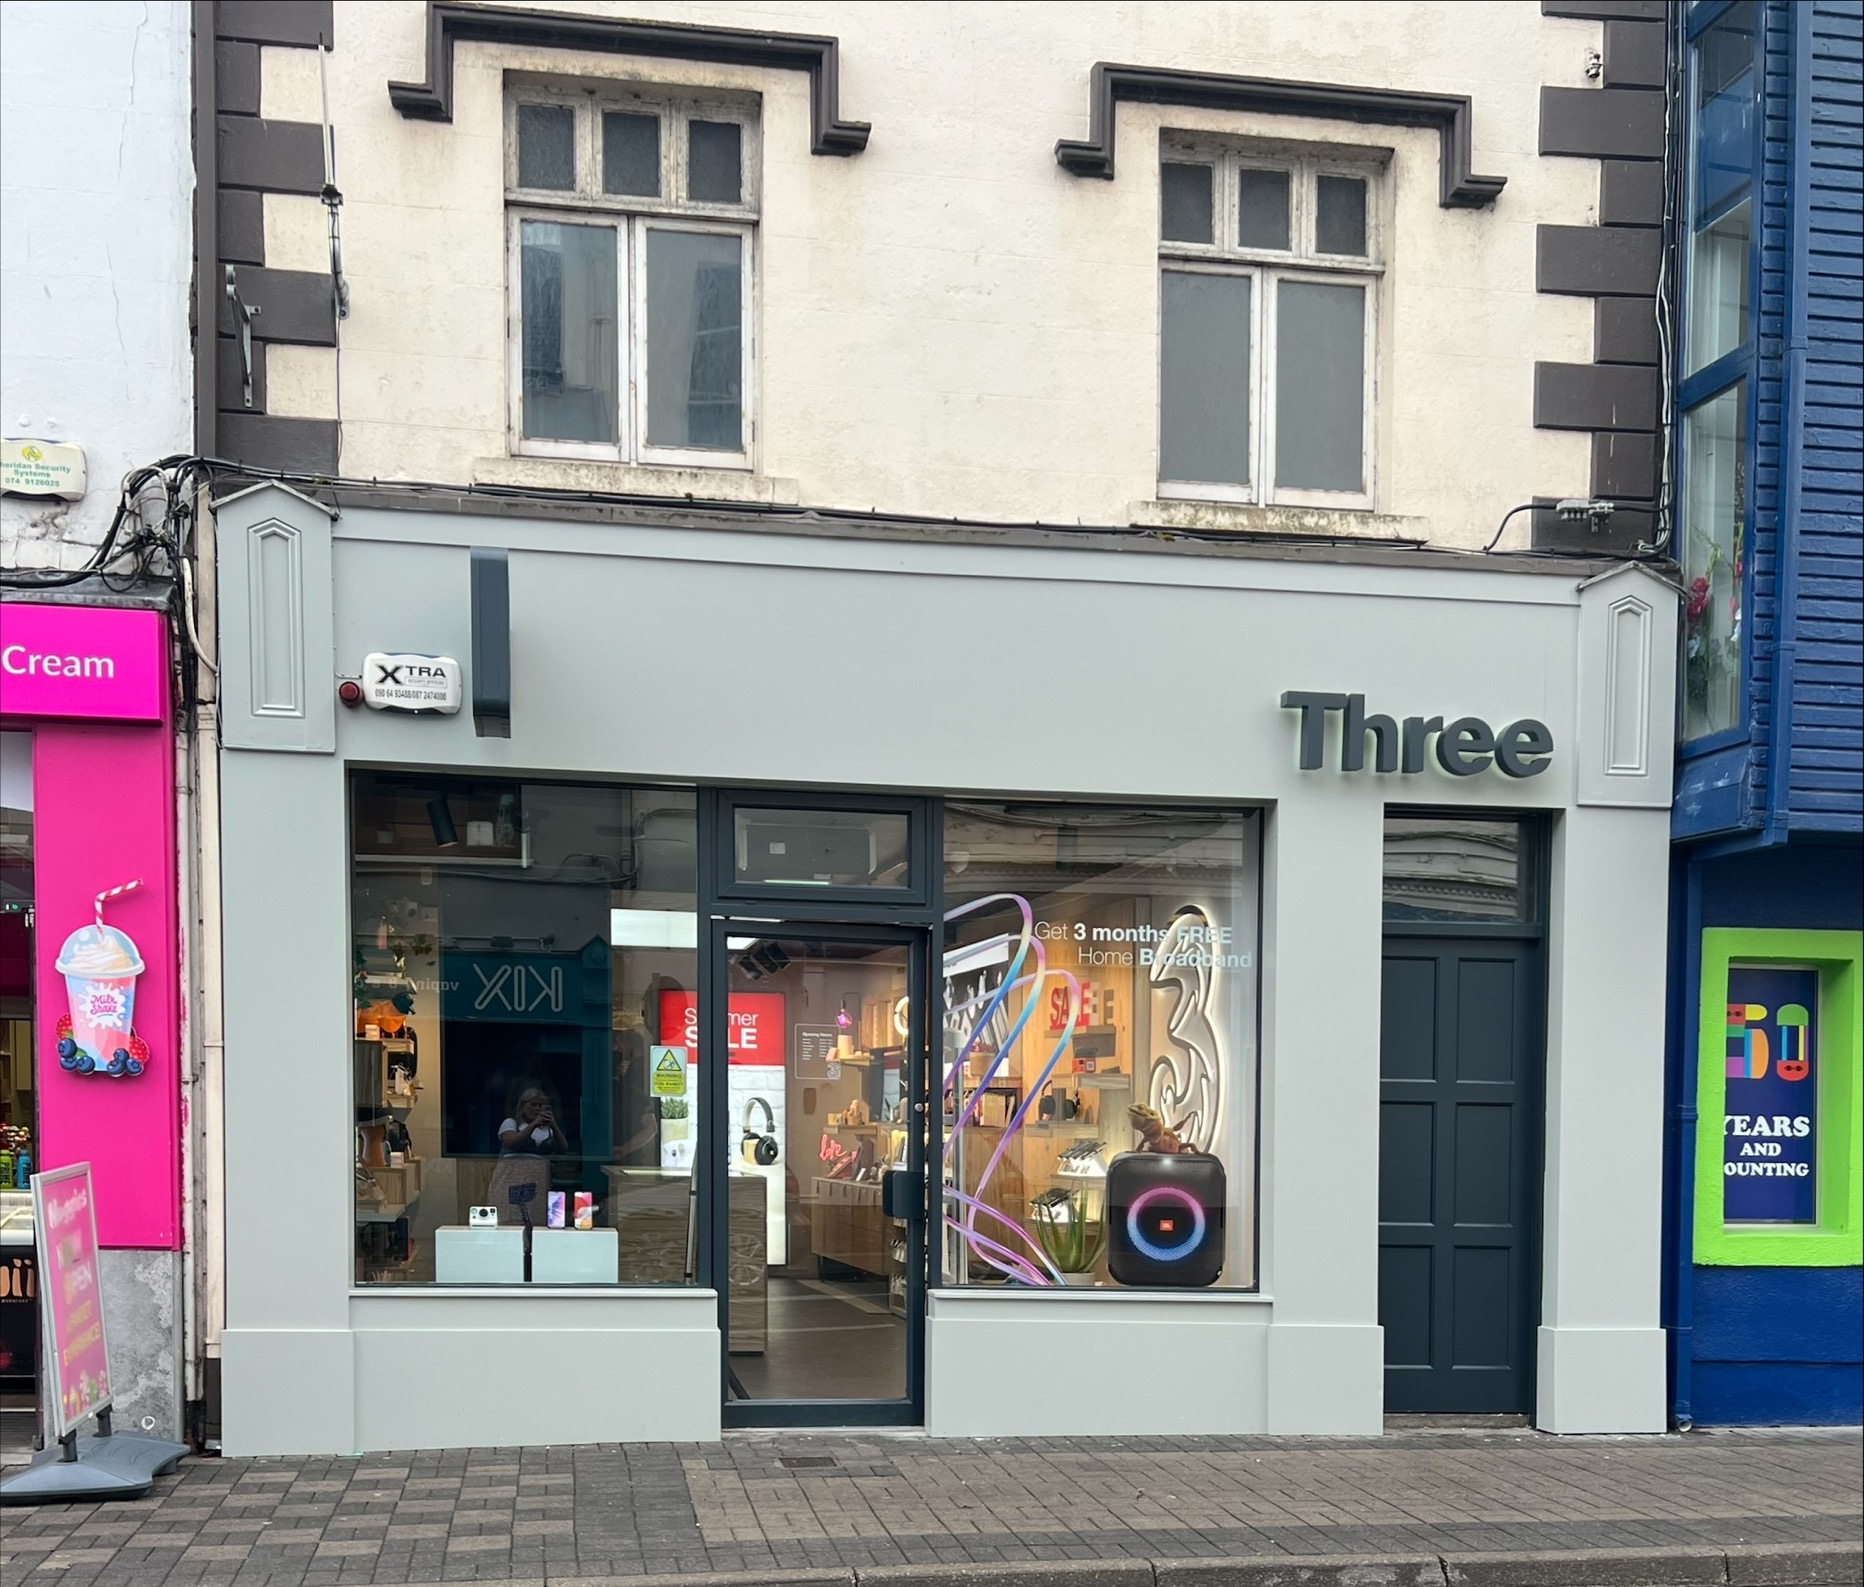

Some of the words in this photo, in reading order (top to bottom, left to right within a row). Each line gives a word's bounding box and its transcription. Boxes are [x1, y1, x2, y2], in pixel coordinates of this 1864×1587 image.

[0, 461, 32, 469] heridan
[35, 463, 71, 474] Security
[14, 469, 51, 478] Systems
[2, 645, 114, 678] Cream
[375, 664, 446, 685] XTRA
[1281, 690, 1554, 778] Three
[1034, 921, 1068, 940] Get
[1073, 922, 1087, 941] 3
[1092, 925, 1168, 942] months
[1177, 926, 1232, 944] FREE
[1078, 947, 1133, 966] Home
[1139, 948, 1251, 967] Boadband
[90, 994, 117, 1004] Milk
[684, 1007, 759, 1026] Smer
[684, 1026, 758, 1049] SLE
[1740, 1142, 1782, 1156] AND
[1724, 1162, 1809, 1176] OUNTING
